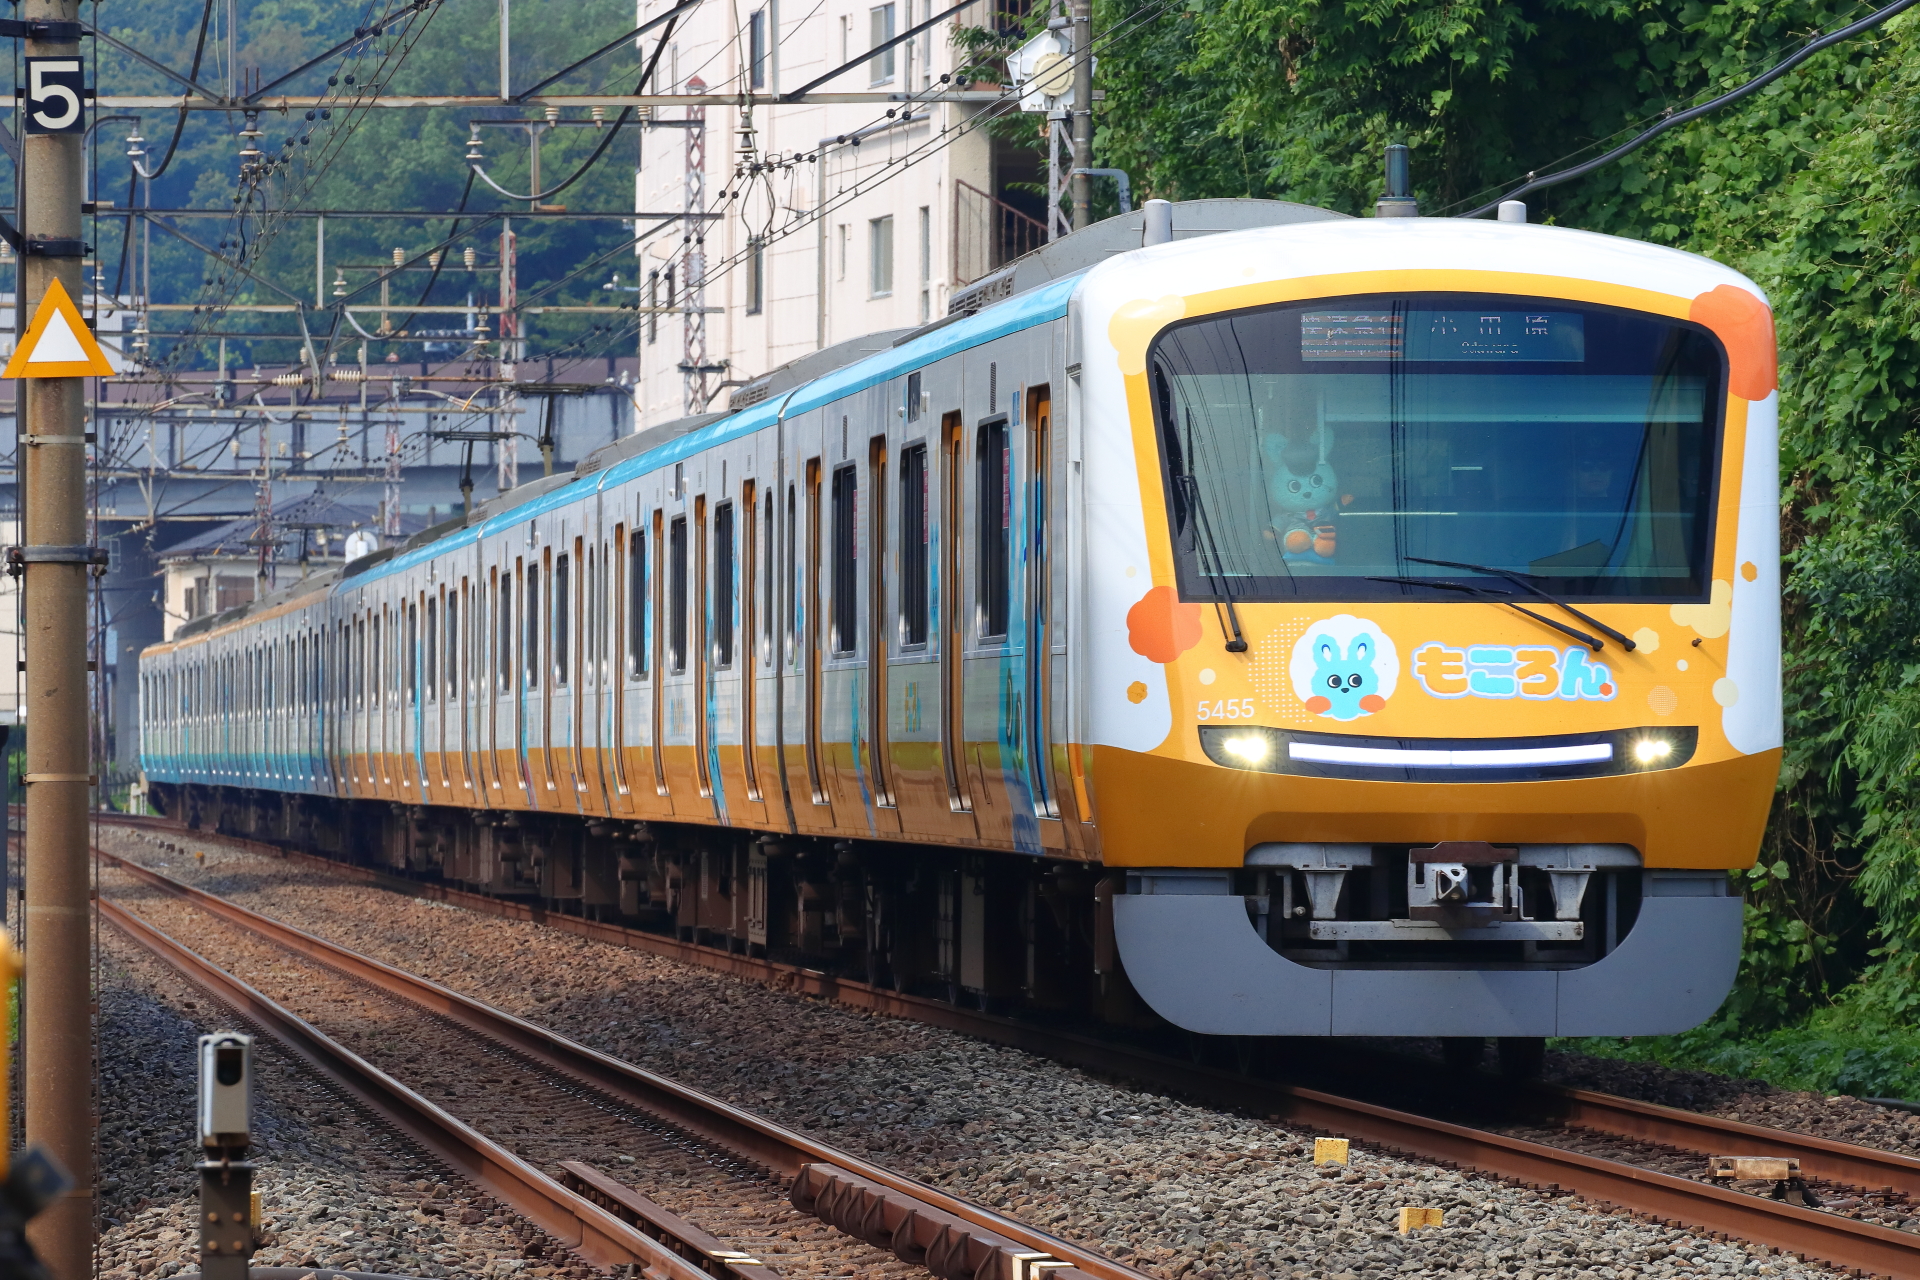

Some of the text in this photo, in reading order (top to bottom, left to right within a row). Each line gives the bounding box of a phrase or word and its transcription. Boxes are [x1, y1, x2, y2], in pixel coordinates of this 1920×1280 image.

[30, 61, 80, 129] 5
[1412, 642, 1617, 701] もころん
[1197, 698, 1255, 720] 5455
